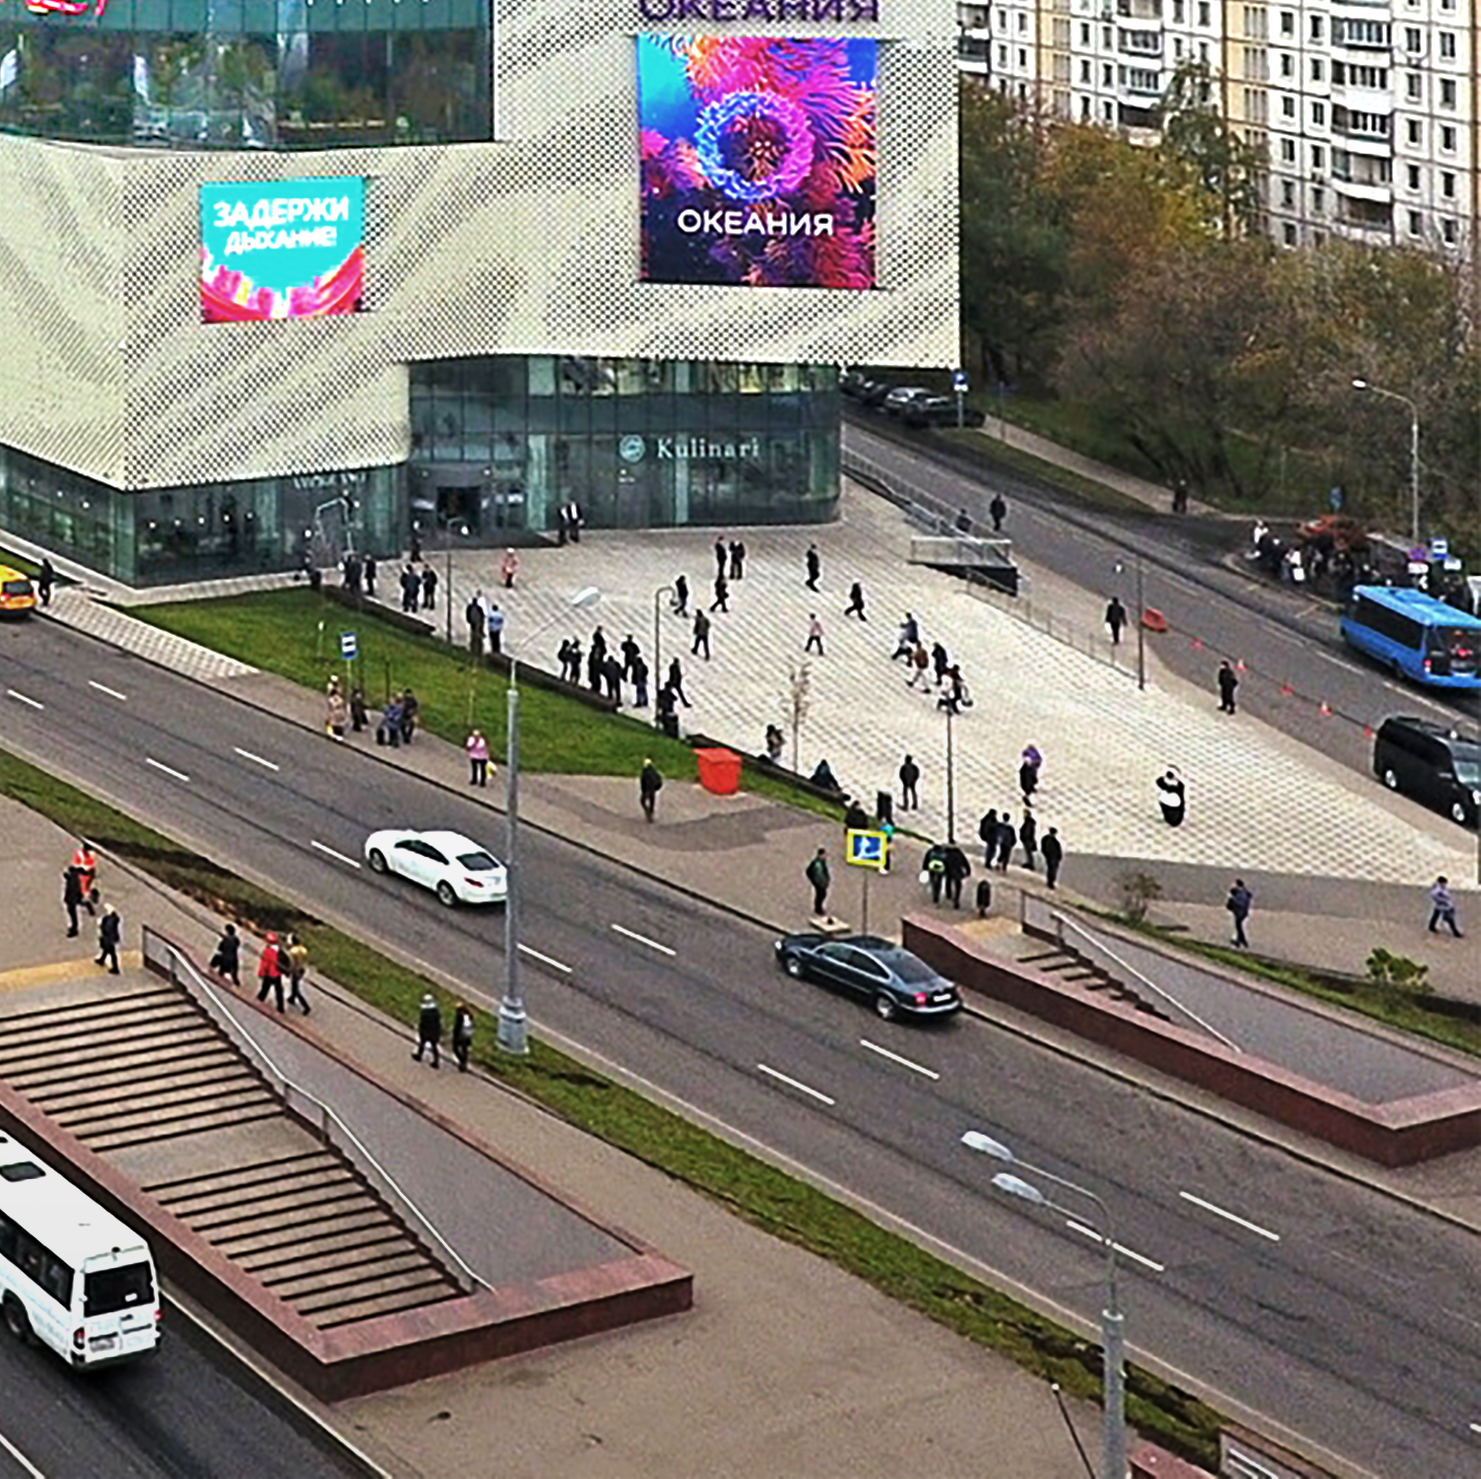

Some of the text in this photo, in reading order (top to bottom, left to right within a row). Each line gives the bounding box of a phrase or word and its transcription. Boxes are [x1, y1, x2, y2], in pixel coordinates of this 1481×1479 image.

[213, 196, 350, 231] ЗАДЕРЖИ
[677, 208, 835, 237] ОКЕАНИЯ
[657, 437, 759, 459] Kulinari
